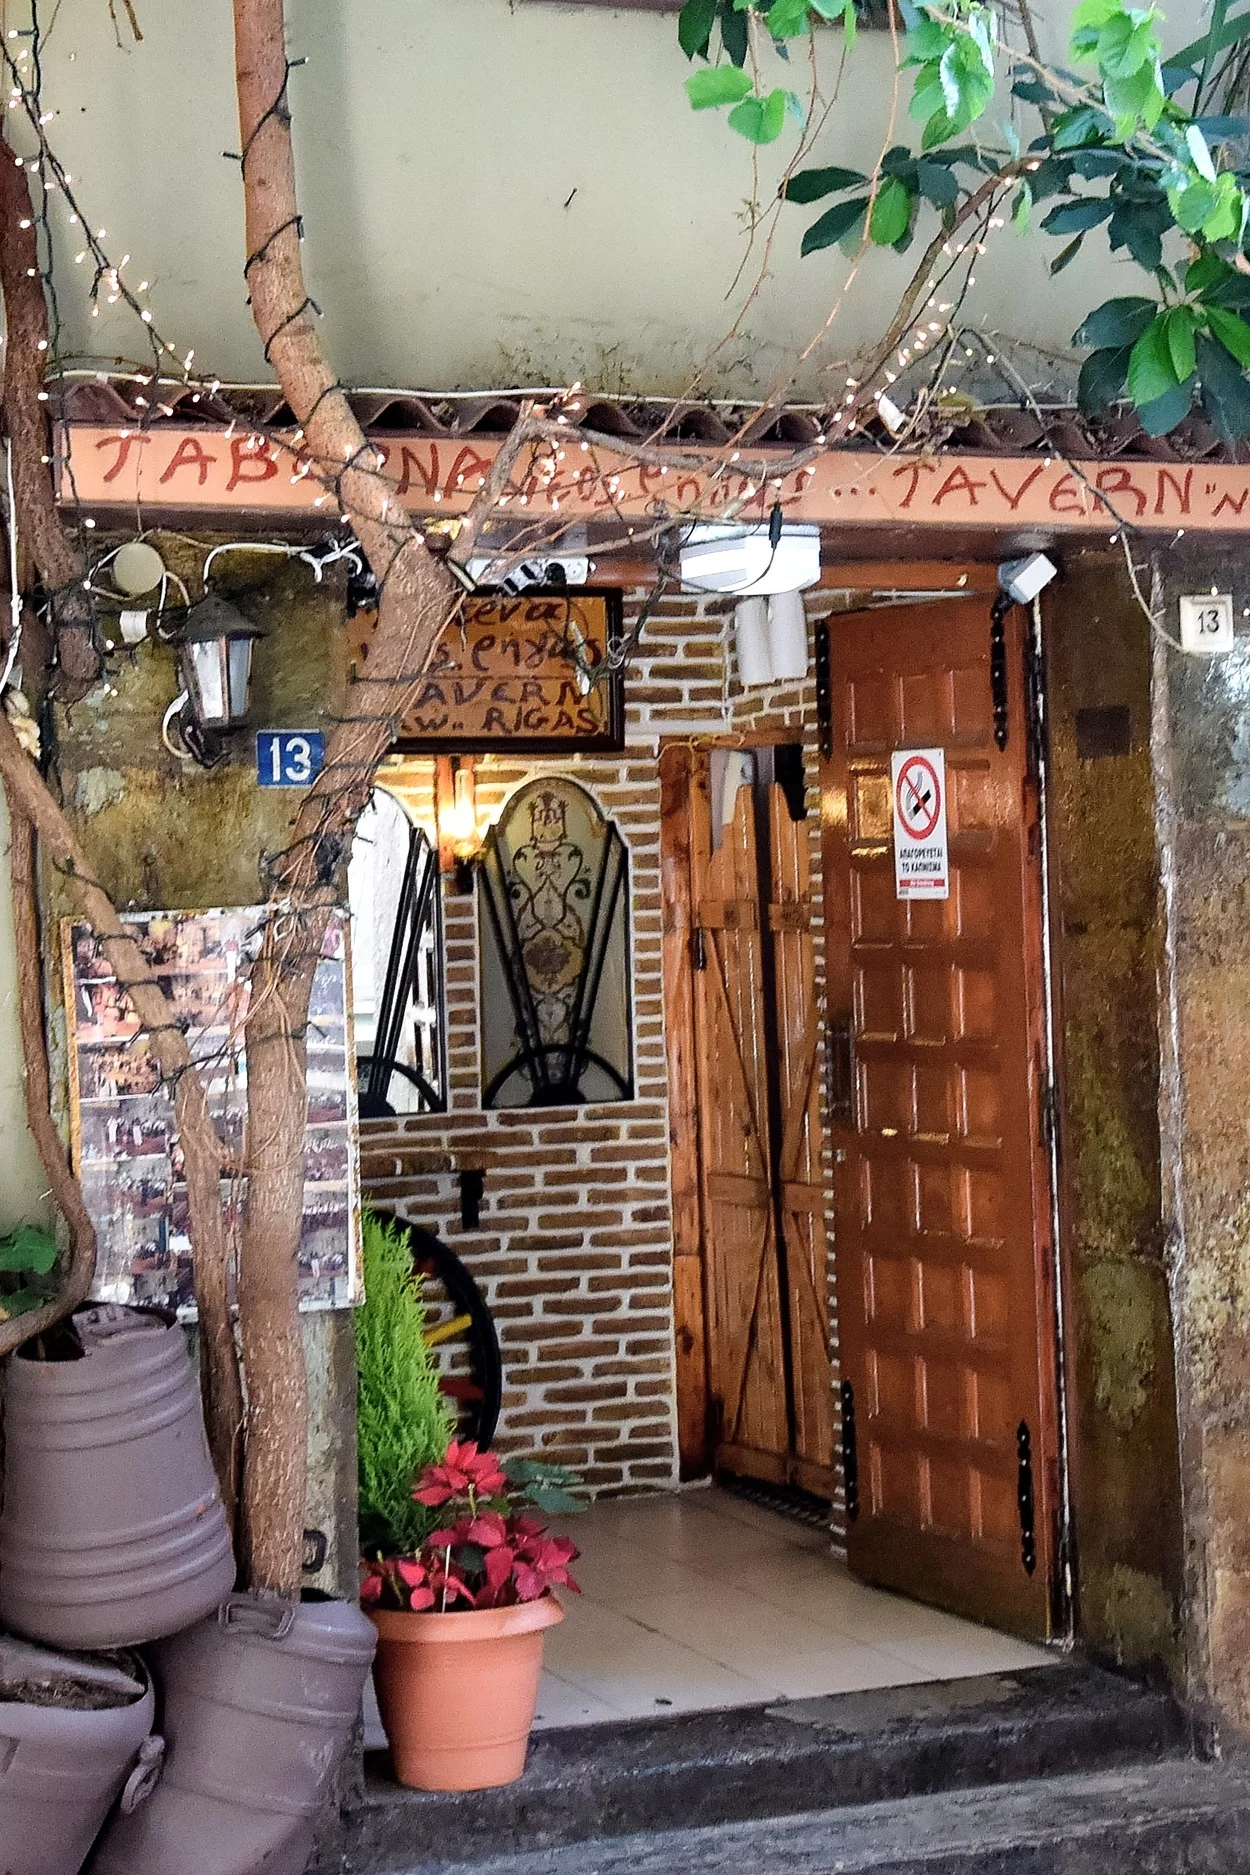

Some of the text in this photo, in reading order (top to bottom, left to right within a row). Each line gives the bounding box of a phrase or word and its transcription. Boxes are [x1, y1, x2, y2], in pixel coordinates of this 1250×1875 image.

[892, 460, 1194, 517] TAVERN
[1197, 609, 1220, 634] 13
[411, 679, 588, 709] AVERN
[480, 706, 600, 735] RIGAS
[269, 736, 312, 782] 13
